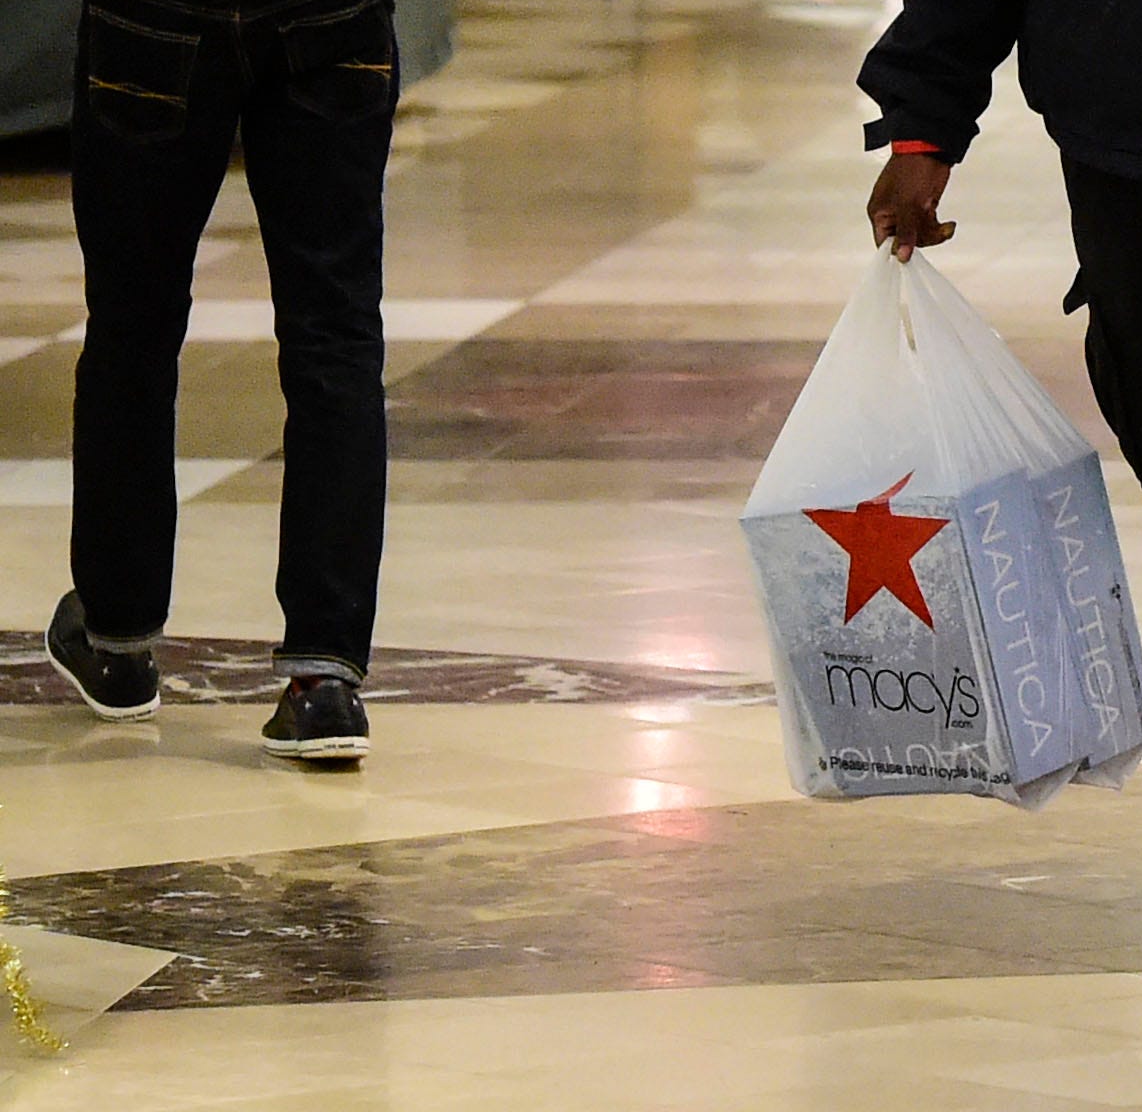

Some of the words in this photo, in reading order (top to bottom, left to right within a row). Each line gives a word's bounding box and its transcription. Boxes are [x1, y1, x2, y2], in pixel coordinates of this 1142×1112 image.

[974, 499, 1053, 758] NAUTICA
[1048, 485, 1121, 742] NAUTICA
[830, 756, 869, 771] Please
[905, 765, 927, 777] and
